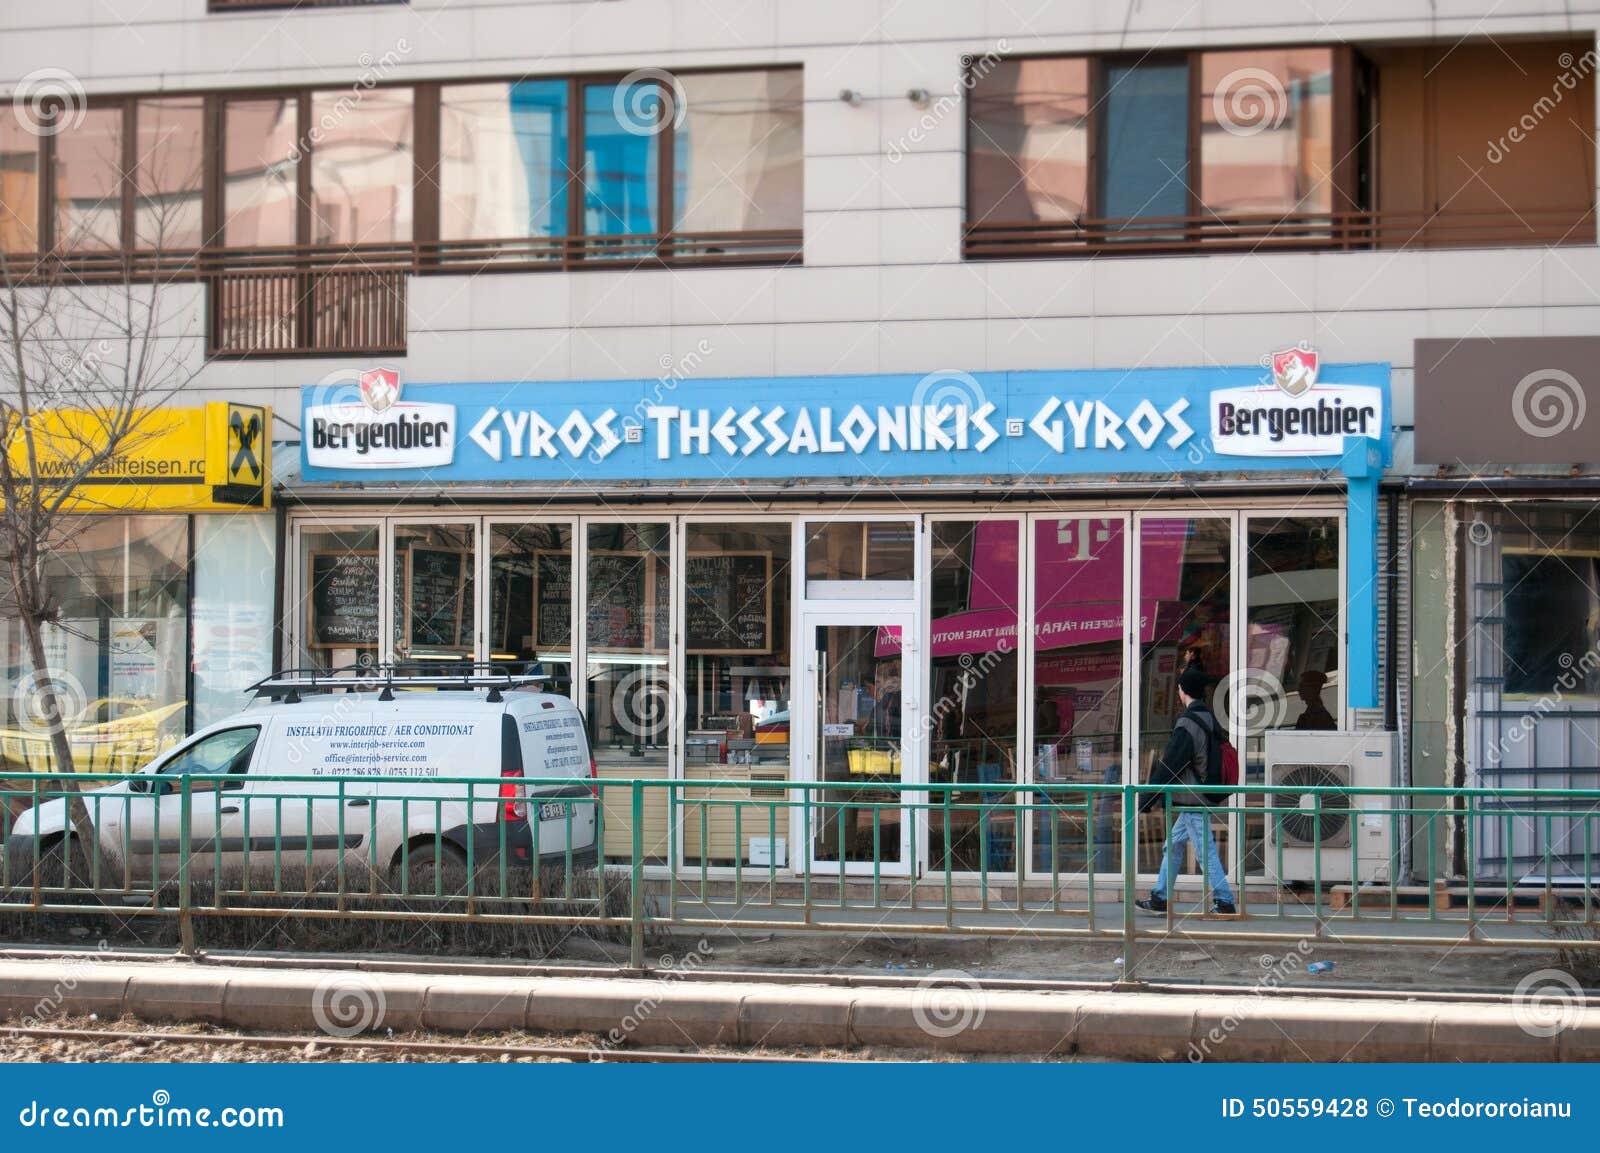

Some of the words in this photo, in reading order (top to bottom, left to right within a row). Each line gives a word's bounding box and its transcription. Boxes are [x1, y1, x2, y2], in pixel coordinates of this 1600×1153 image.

[468, 406, 623, 461] GYROS
[647, 400, 1001, 460] THESSALONIKIS
[1028, 396, 1195, 453] GYROS
[1218, 397, 1374, 442] Bergenbier
[312, 413, 448, 455] Bergenbier
[37, 455, 205, 474] wwwaiffeisen.ro
[334, 725, 388, 737] FRIGORIFICE
[394, 725, 412, 736] AER
[413, 724, 474, 736] CONDITIONAT
[330, 739, 425, 751] www.interjob-service.com
[324, 752, 428, 764] office@interjob-service.com
